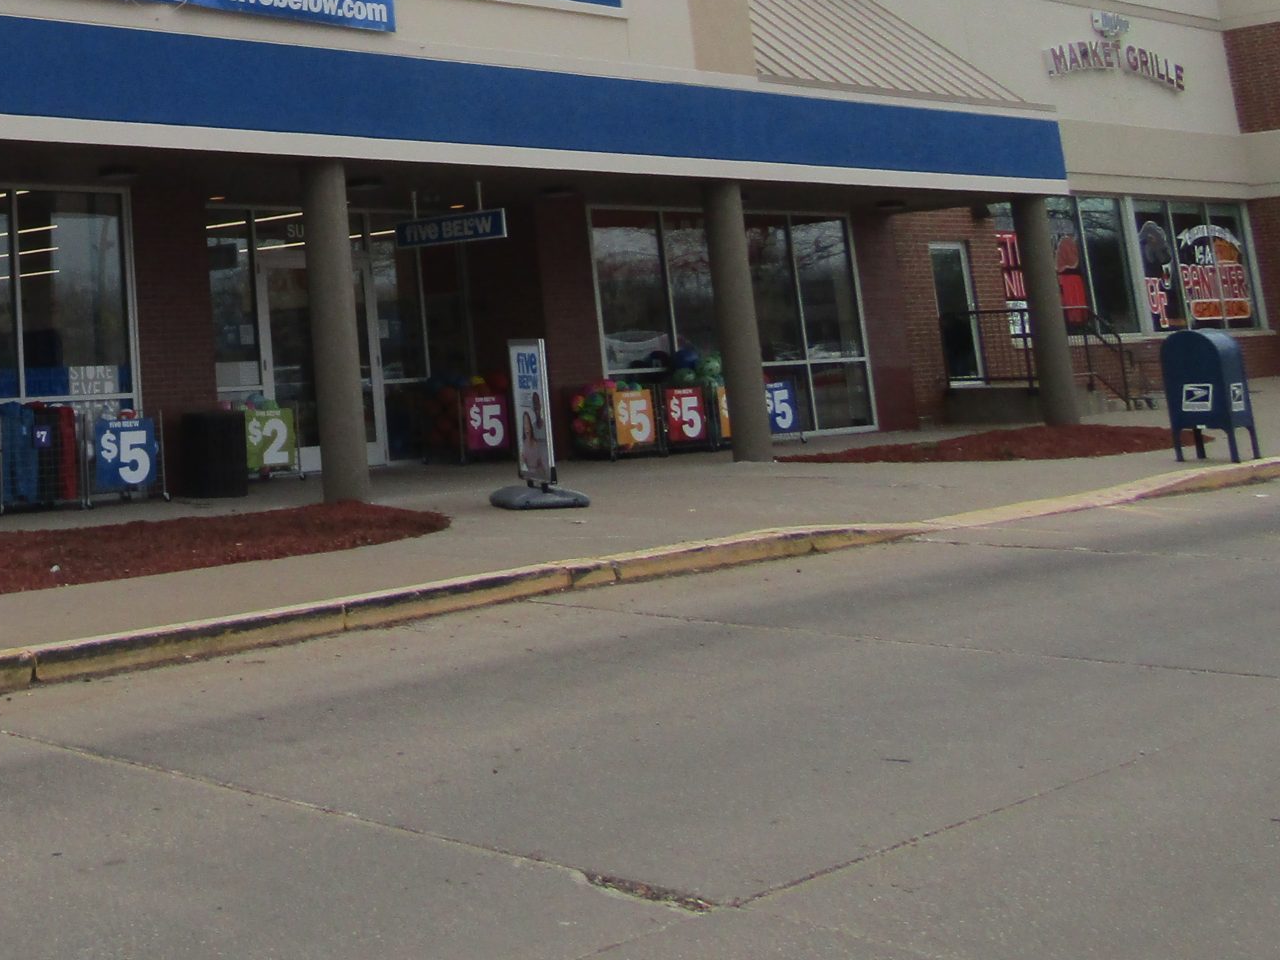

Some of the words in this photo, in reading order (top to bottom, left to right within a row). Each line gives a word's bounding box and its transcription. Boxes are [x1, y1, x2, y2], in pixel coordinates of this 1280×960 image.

[1050, 40, 1121, 74] MARKET
[1126, 45, 1185, 91] GRILLE
[406, 222, 439, 242] five
[442, 215, 492, 238] BELOW
[517, 352, 537, 374] five
[36, 430, 47, 443] $7
[469, 404, 504, 446] $5
[617, 399, 651, 442] $5
[670, 396, 702, 438] $5
[100, 429, 150, 484] $5
[248, 417, 289, 464] $2
